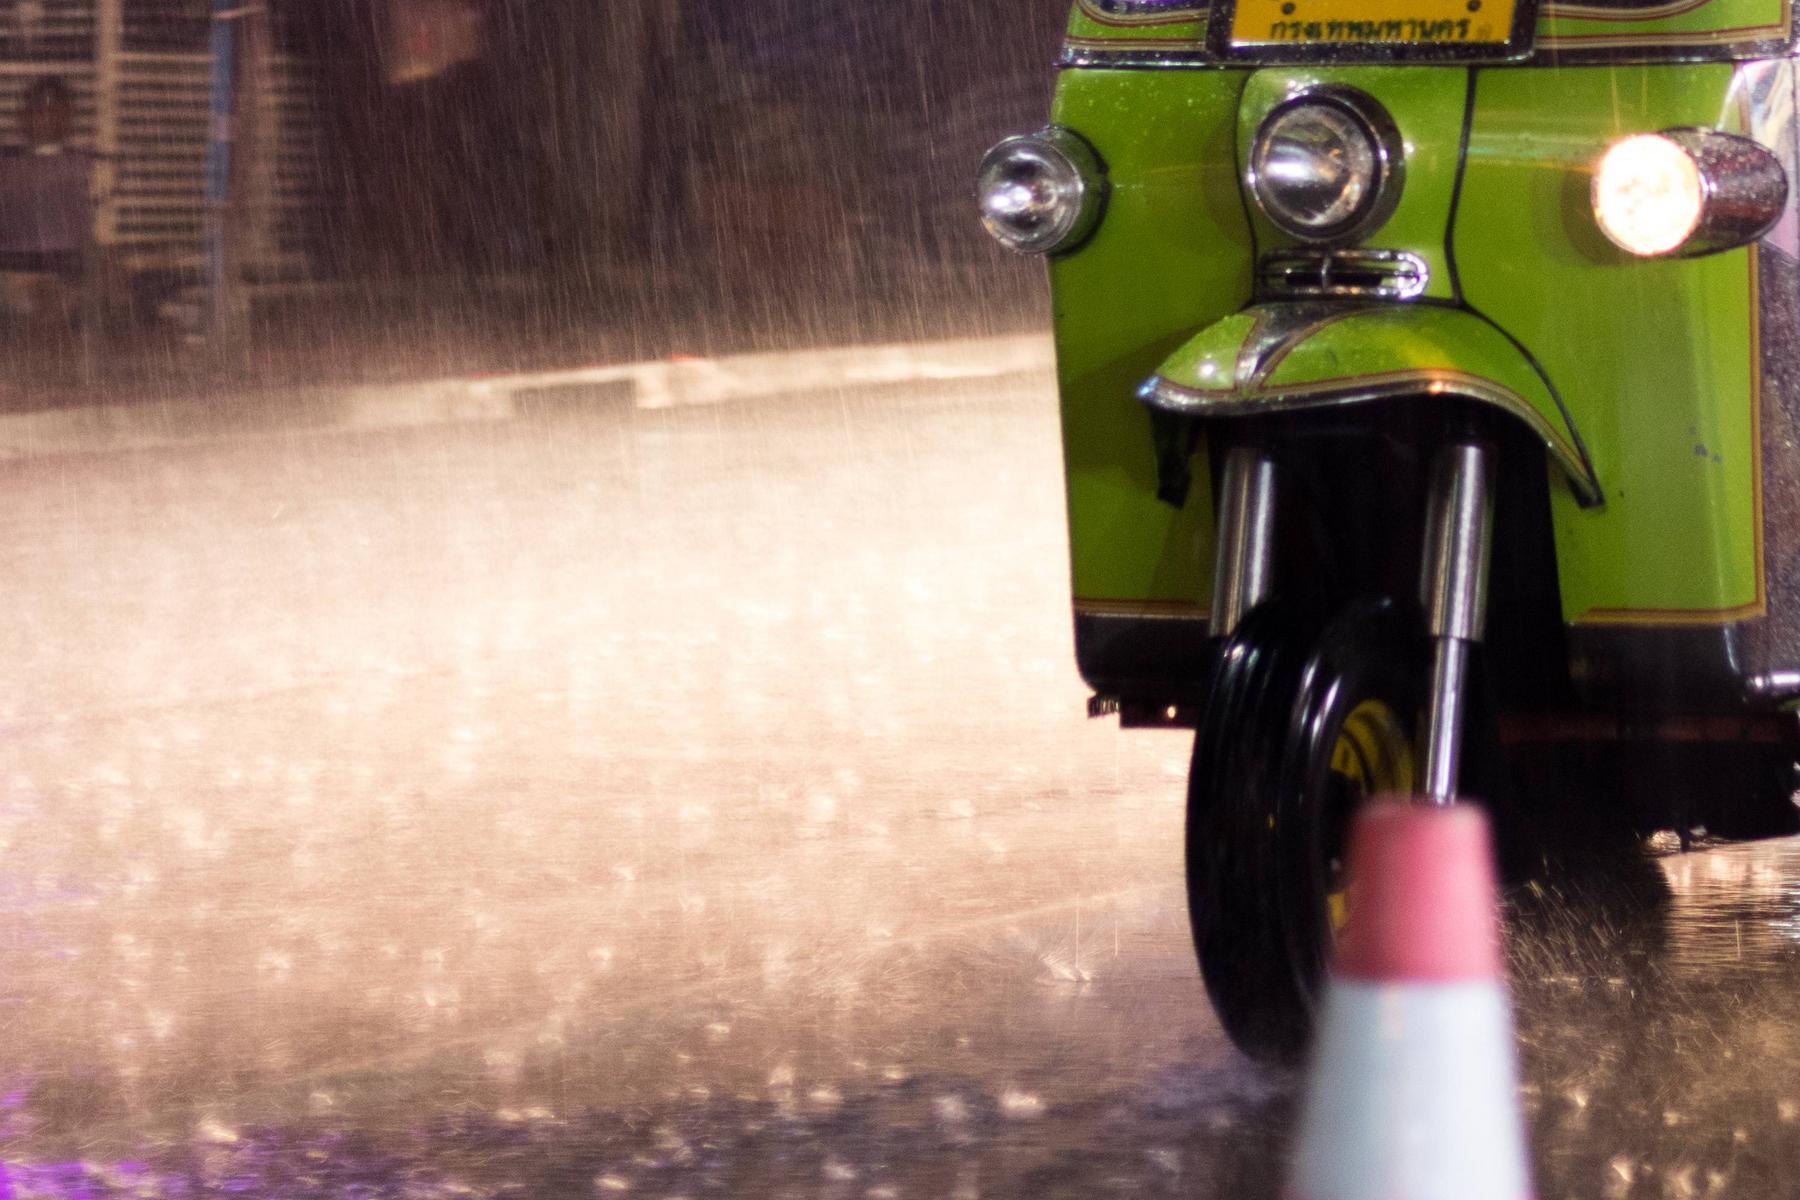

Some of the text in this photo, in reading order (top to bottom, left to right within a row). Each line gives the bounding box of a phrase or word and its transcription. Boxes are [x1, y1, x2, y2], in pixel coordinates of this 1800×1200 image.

[1270, 19, 1473, 41] กรงเทพมหานคร
